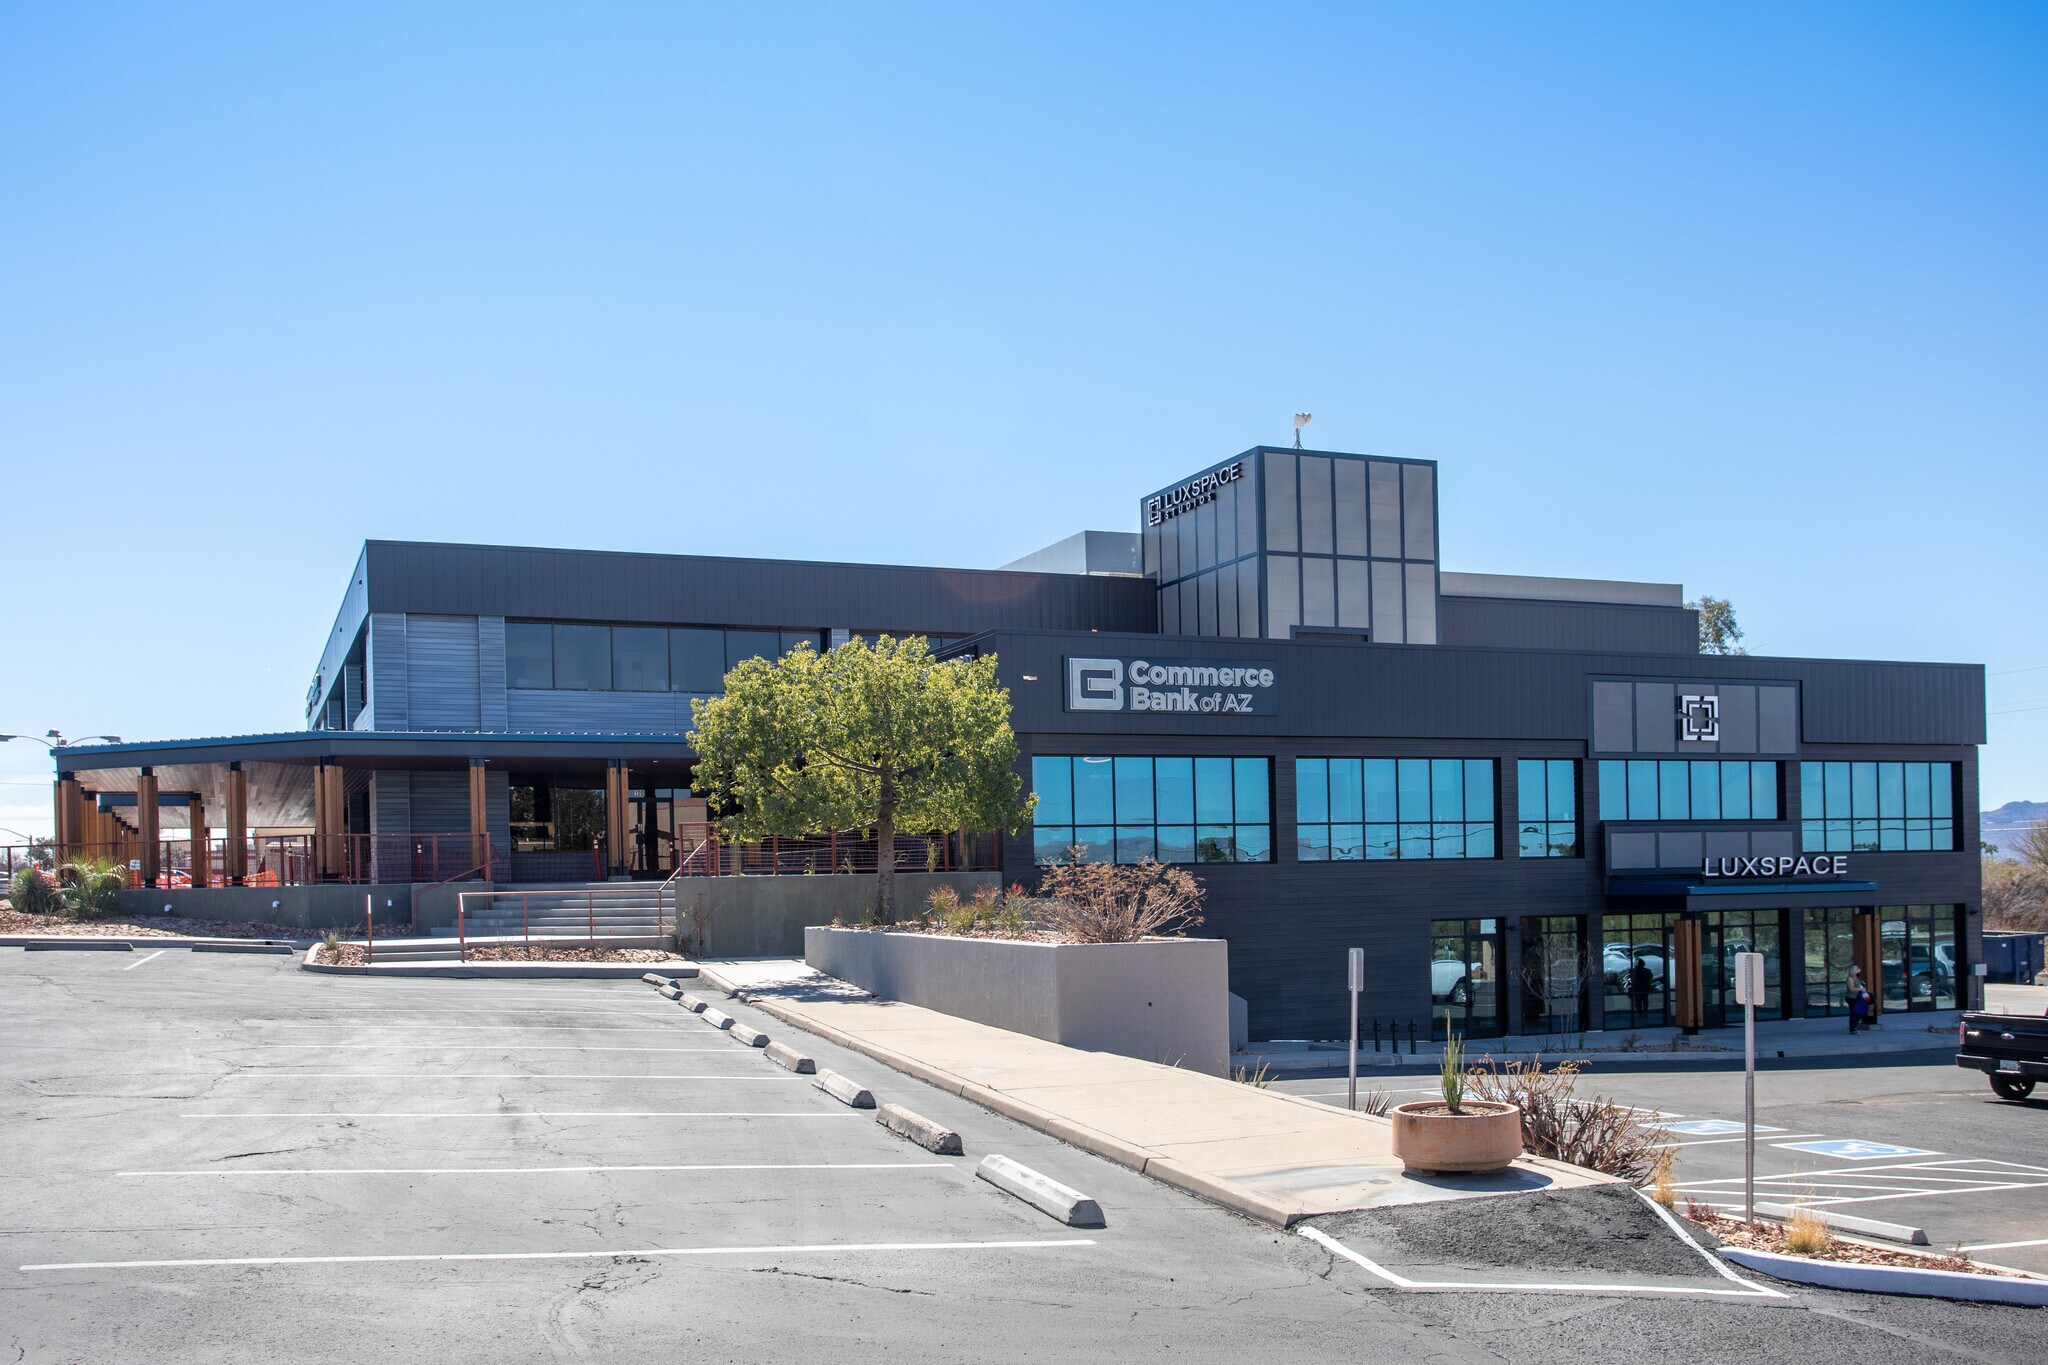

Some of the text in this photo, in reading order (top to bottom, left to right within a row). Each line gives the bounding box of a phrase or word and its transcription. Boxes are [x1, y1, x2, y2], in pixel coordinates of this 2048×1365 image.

[1165, 462, 1241, 509] LUXSPACE
[1165, 492, 1213, 520] STUDIOS
[1129, 660, 1274, 688] Commerce
[1129, 687, 1254, 713] Bank of AZ
[1703, 855, 1848, 877] LUXSPACE
